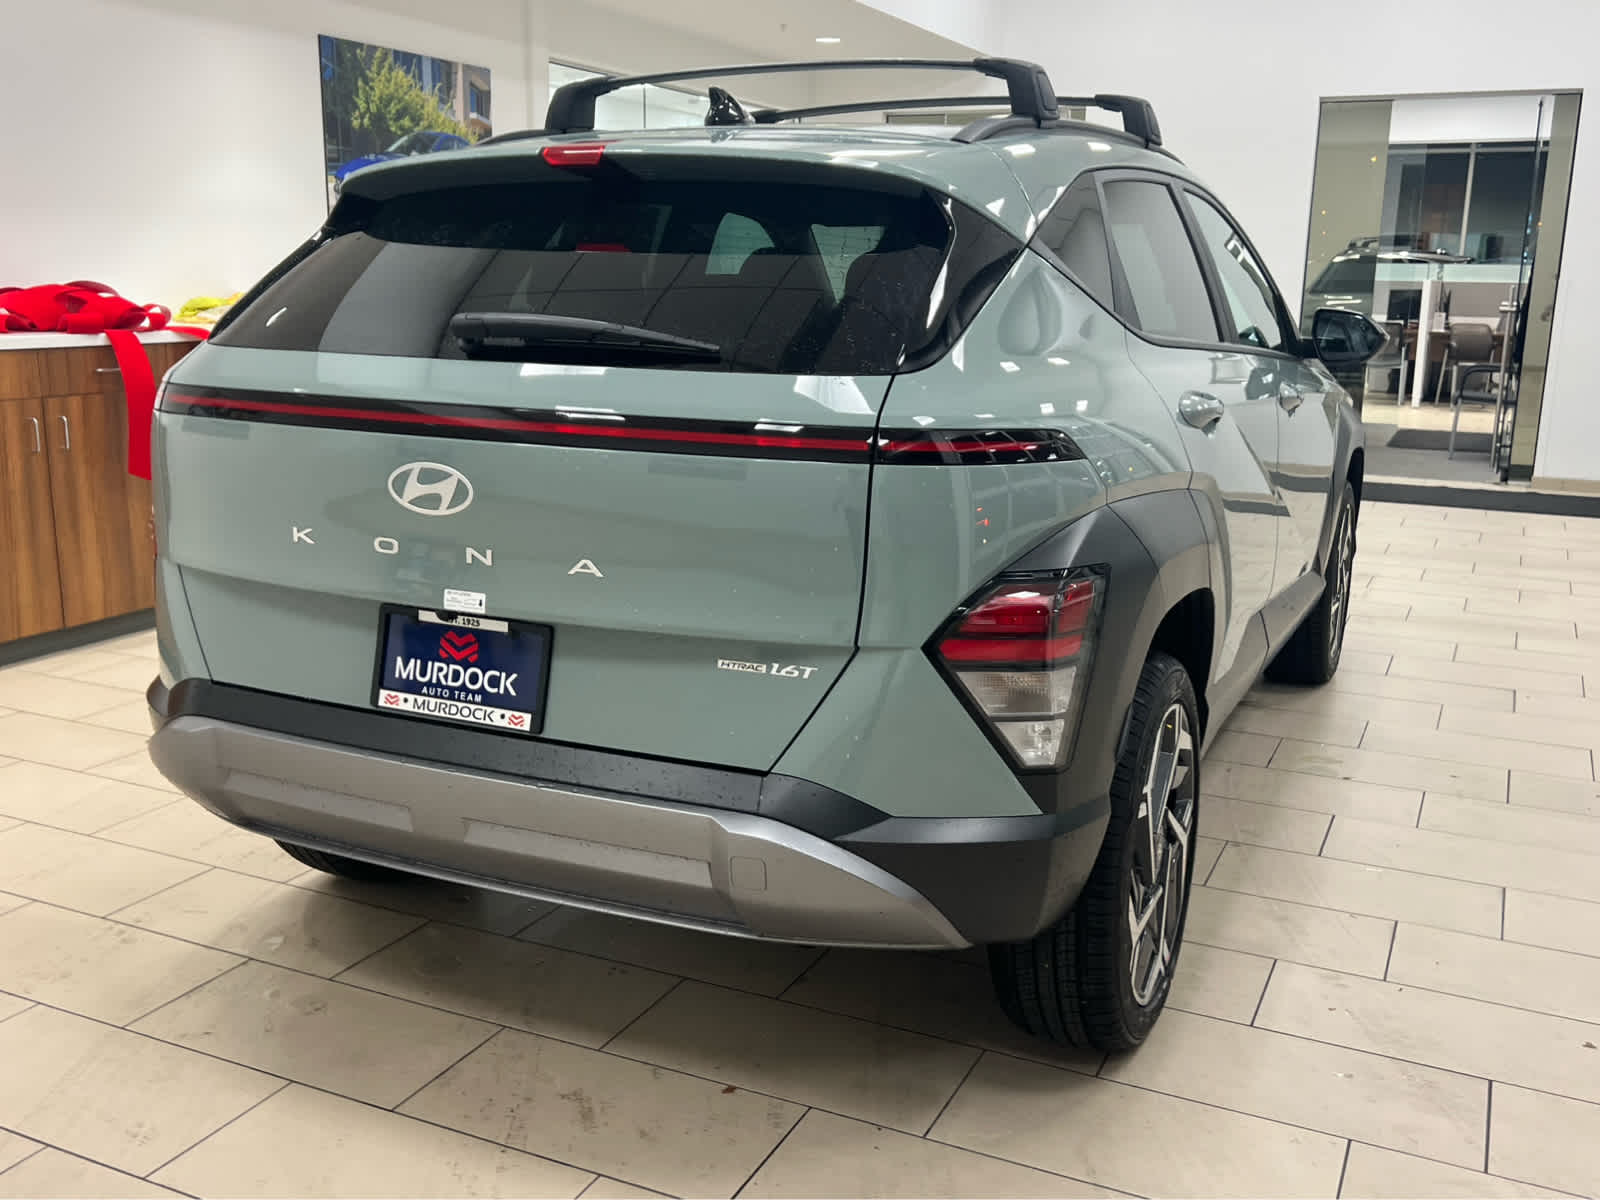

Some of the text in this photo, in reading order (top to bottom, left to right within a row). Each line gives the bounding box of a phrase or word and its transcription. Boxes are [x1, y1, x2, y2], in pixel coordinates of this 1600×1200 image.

[292, 526, 604, 578] KONA
[462, 617, 481, 628] 1925
[395, 656, 518, 696] MURDOCK
[719, 660, 765, 673] HTRAC
[421, 686, 482, 704] AUTO TEAM
[412, 697, 495, 722] MURDOCK
